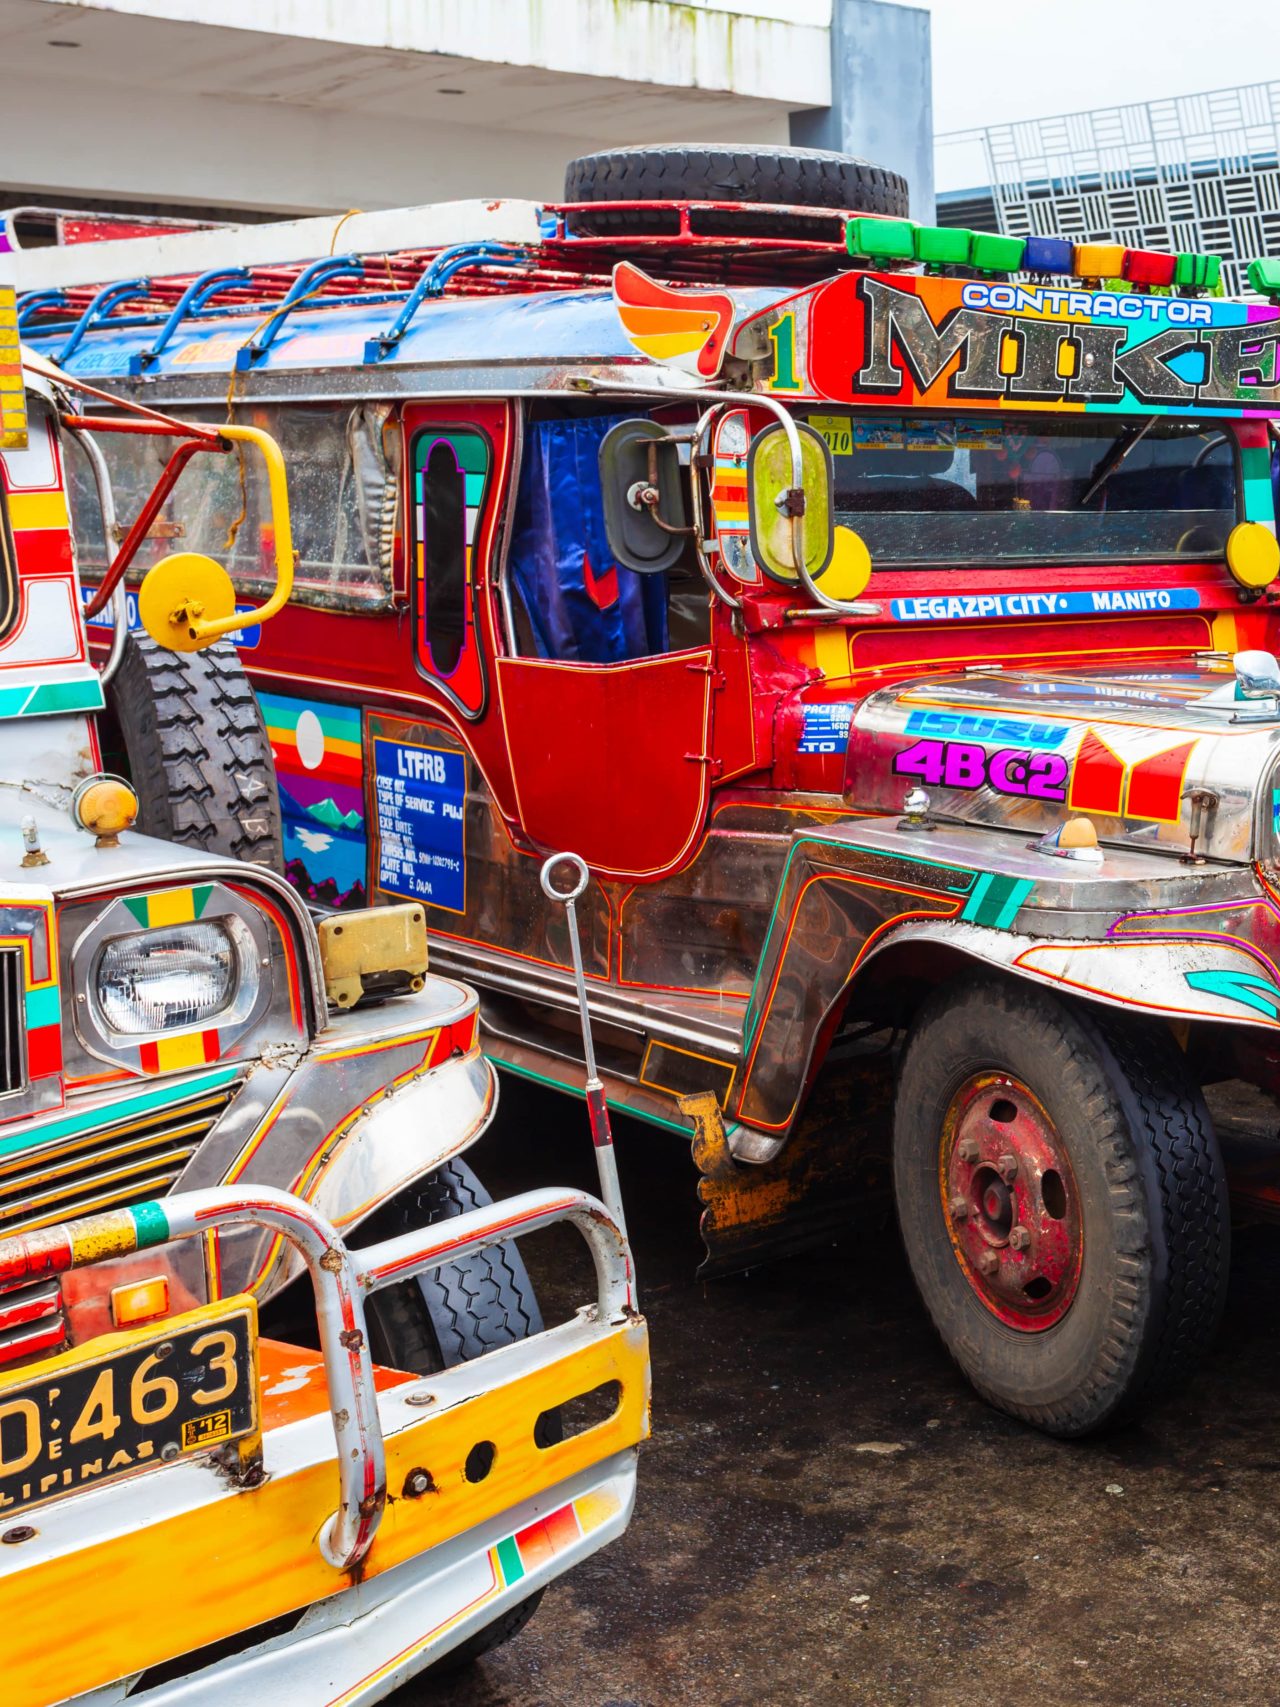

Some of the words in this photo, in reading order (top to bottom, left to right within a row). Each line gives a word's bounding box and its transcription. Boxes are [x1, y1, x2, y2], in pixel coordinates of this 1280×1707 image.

[962, 284, 1213, 325] CONTRACTOR
[768, 311, 803, 392] 1
[823, 431, 849, 451] 010
[898, 598, 1002, 620] LEGAZPI
[1092, 590, 1171, 611] MANITO
[802, 704, 846, 714] PACITY
[905, 711, 1069, 746] ISUZU
[397, 748, 447, 783] LTFRB
[376, 775, 393, 790] CASE
[377, 789, 394, 805] TYPE
[394, 793, 404, 807] OF
[442, 802, 464, 820] PUJ
[381, 855, 401, 873] PLATE
[416, 878, 433, 895] DAPA
[70, 1330, 239, 1446] 463
